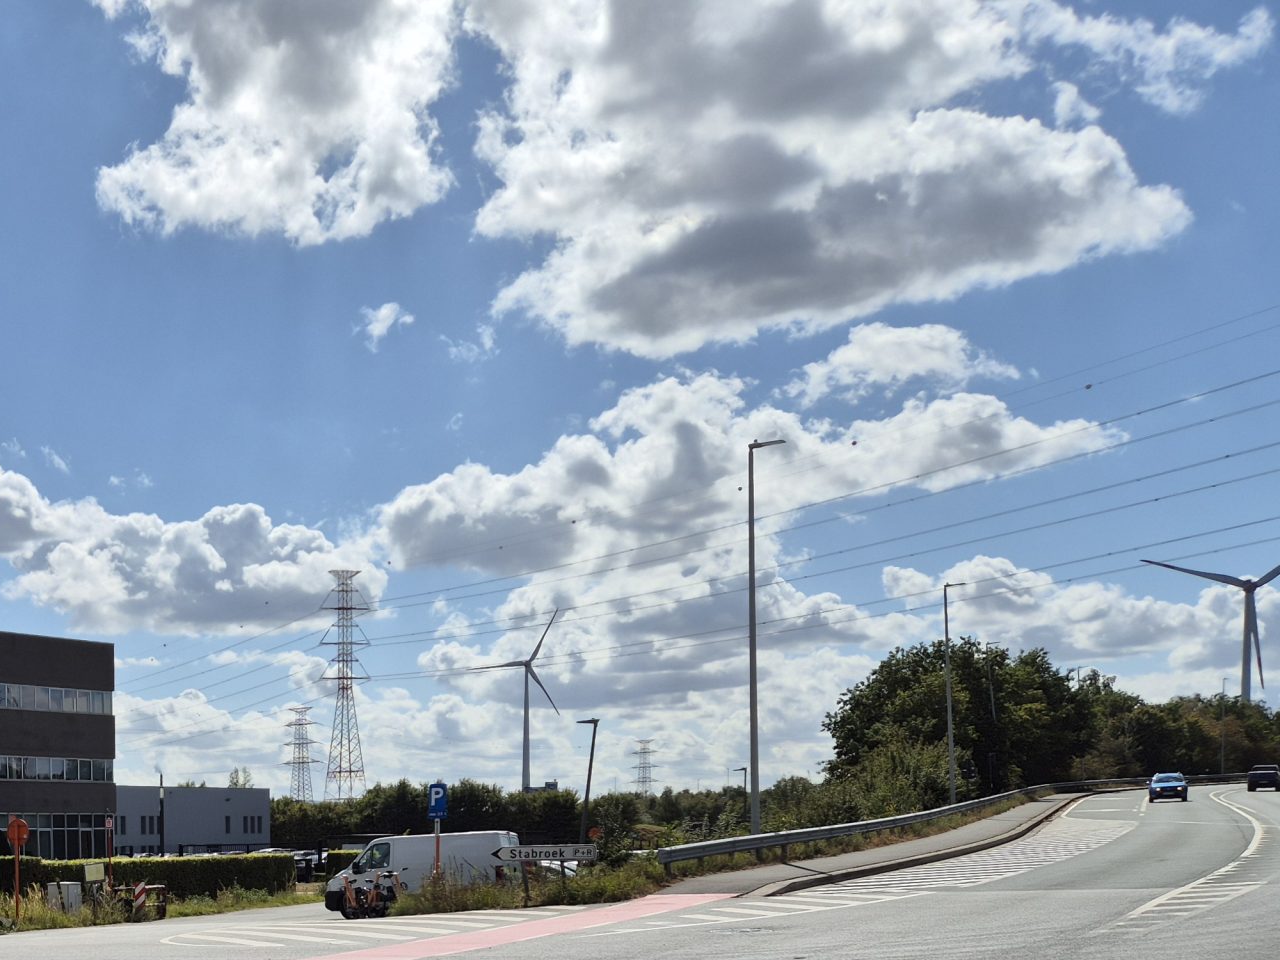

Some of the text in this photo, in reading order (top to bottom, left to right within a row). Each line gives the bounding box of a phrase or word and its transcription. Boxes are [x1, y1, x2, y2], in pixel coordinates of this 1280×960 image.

[431, 787, 444, 807] P
[510, 847, 593, 859] Stabroek P+R
